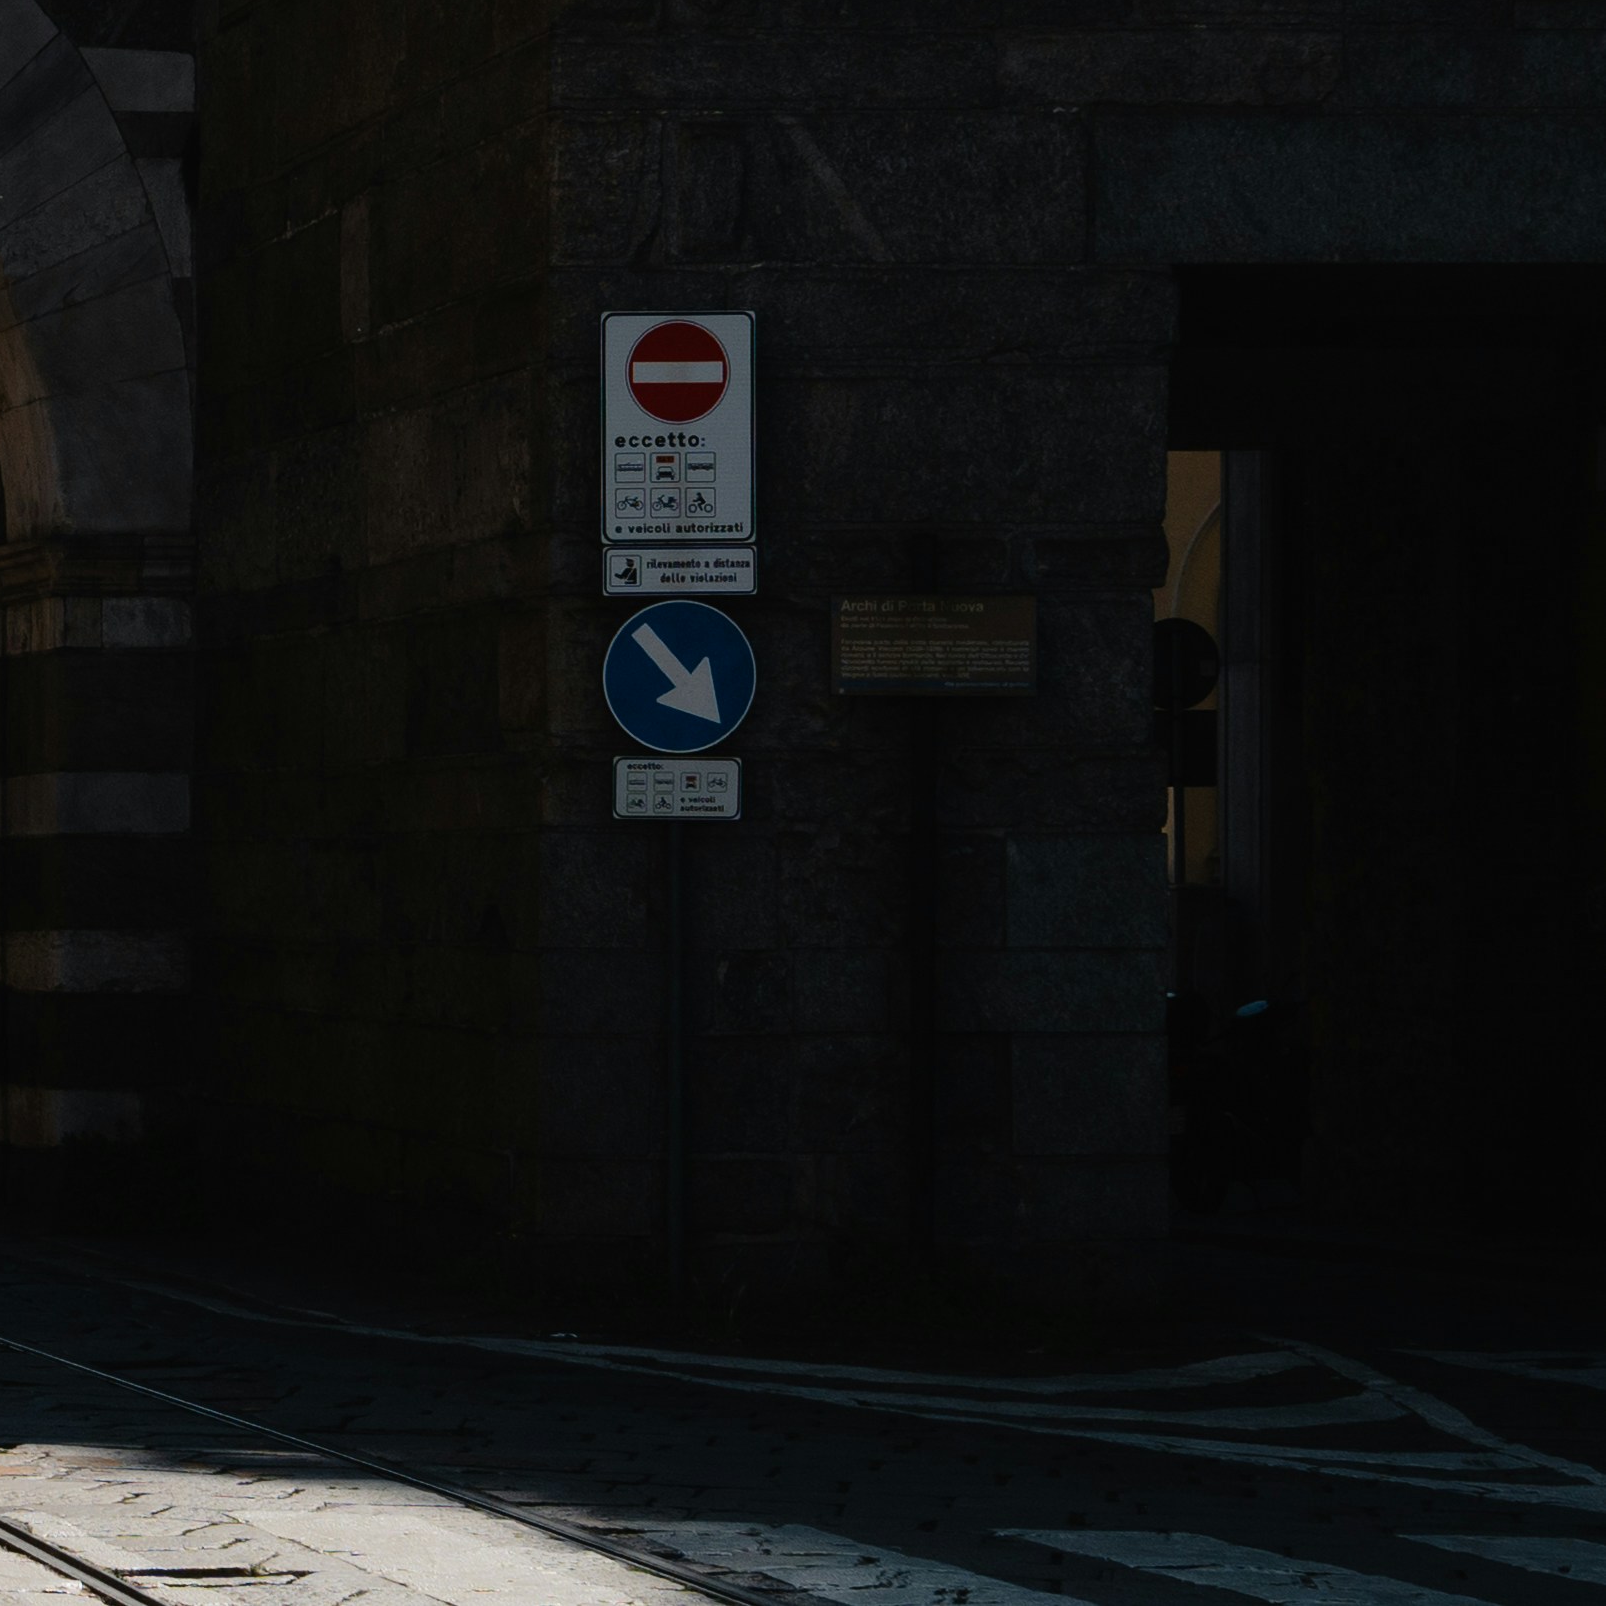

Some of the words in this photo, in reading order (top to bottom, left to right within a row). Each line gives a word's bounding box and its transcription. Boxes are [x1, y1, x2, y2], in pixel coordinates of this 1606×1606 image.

[615, 432, 704, 447] eccetto:
[628, 523, 670, 533] veicoli
[676, 523, 743, 533] autorizzati
[647, 559, 700, 568] rilevamento
[714, 558, 750, 568] distanza
[660, 573, 685, 583] delle
[690, 573, 737, 582] violazioni
[841, 600, 877, 612] Archi
[881, 600, 894, 612] di
